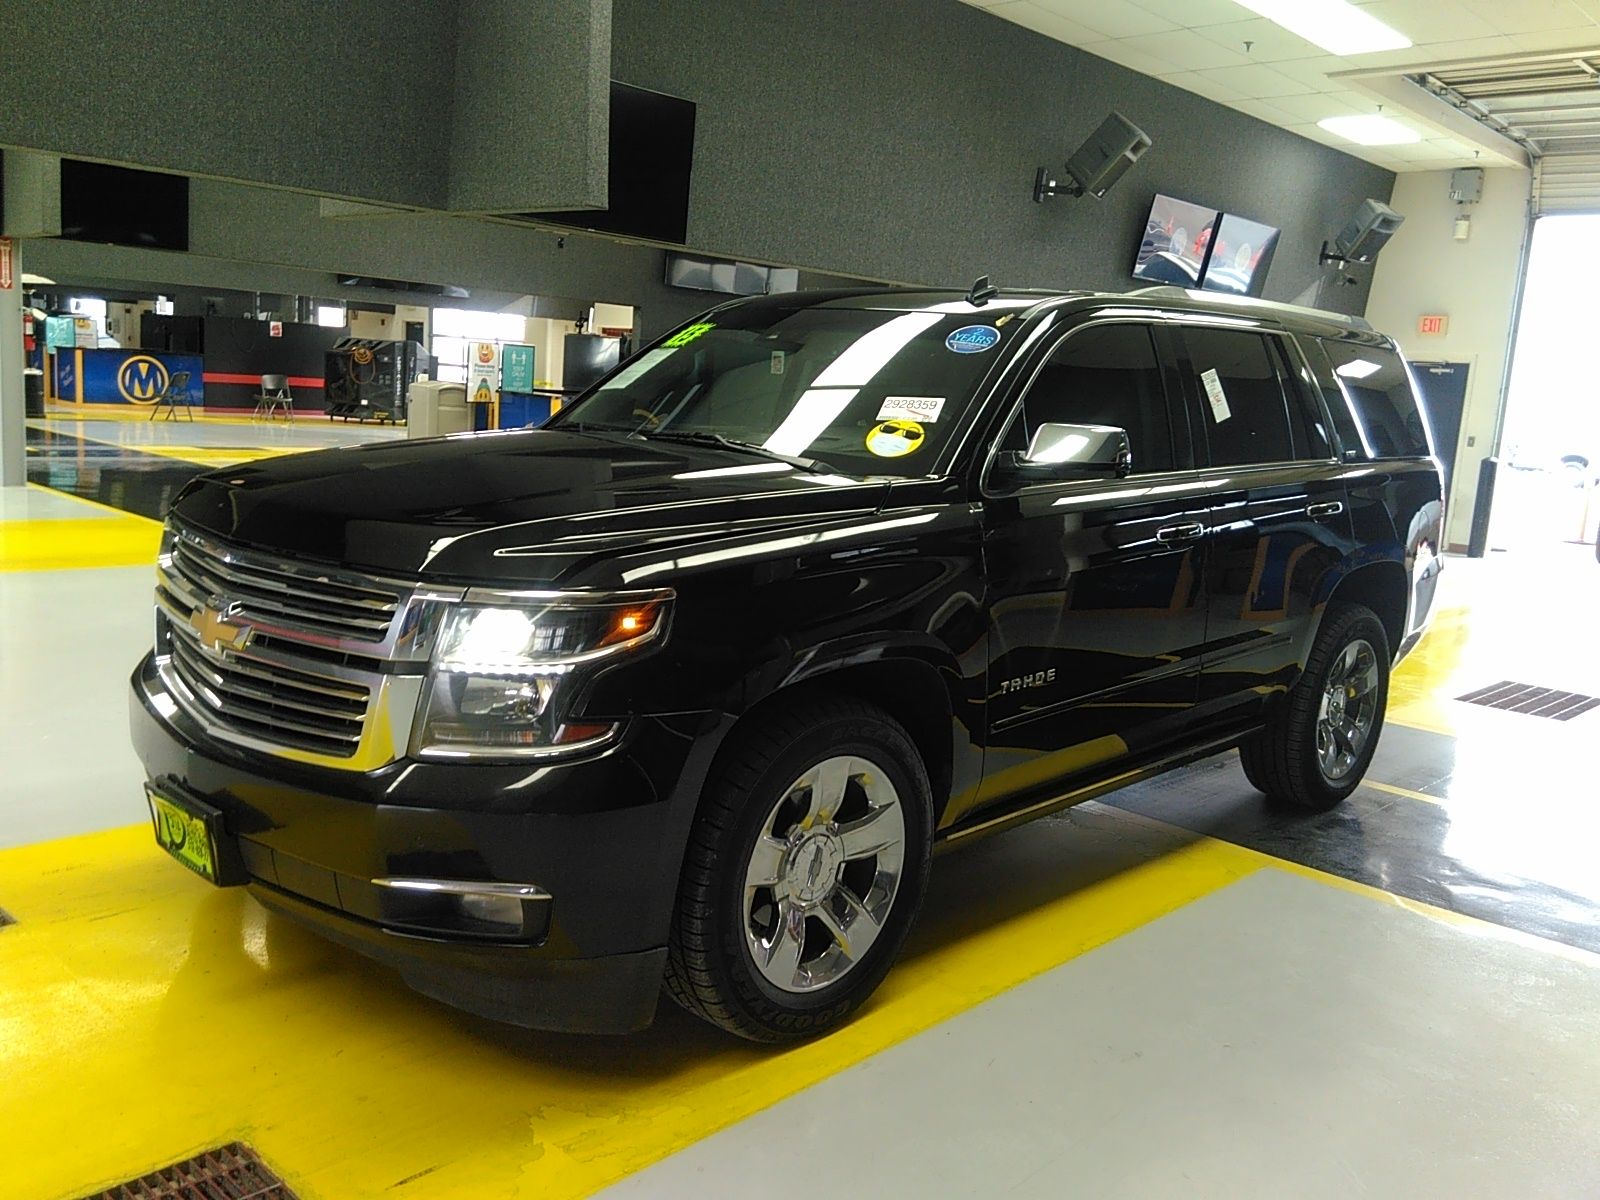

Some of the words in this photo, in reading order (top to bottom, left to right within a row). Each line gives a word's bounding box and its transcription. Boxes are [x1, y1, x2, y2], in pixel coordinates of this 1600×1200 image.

[1421, 317, 1442, 333] EXIT
[954, 333, 995, 346] YEARS
[884, 399, 938, 411] 2928359
[1001, 668, 1056, 694] TAHOE
